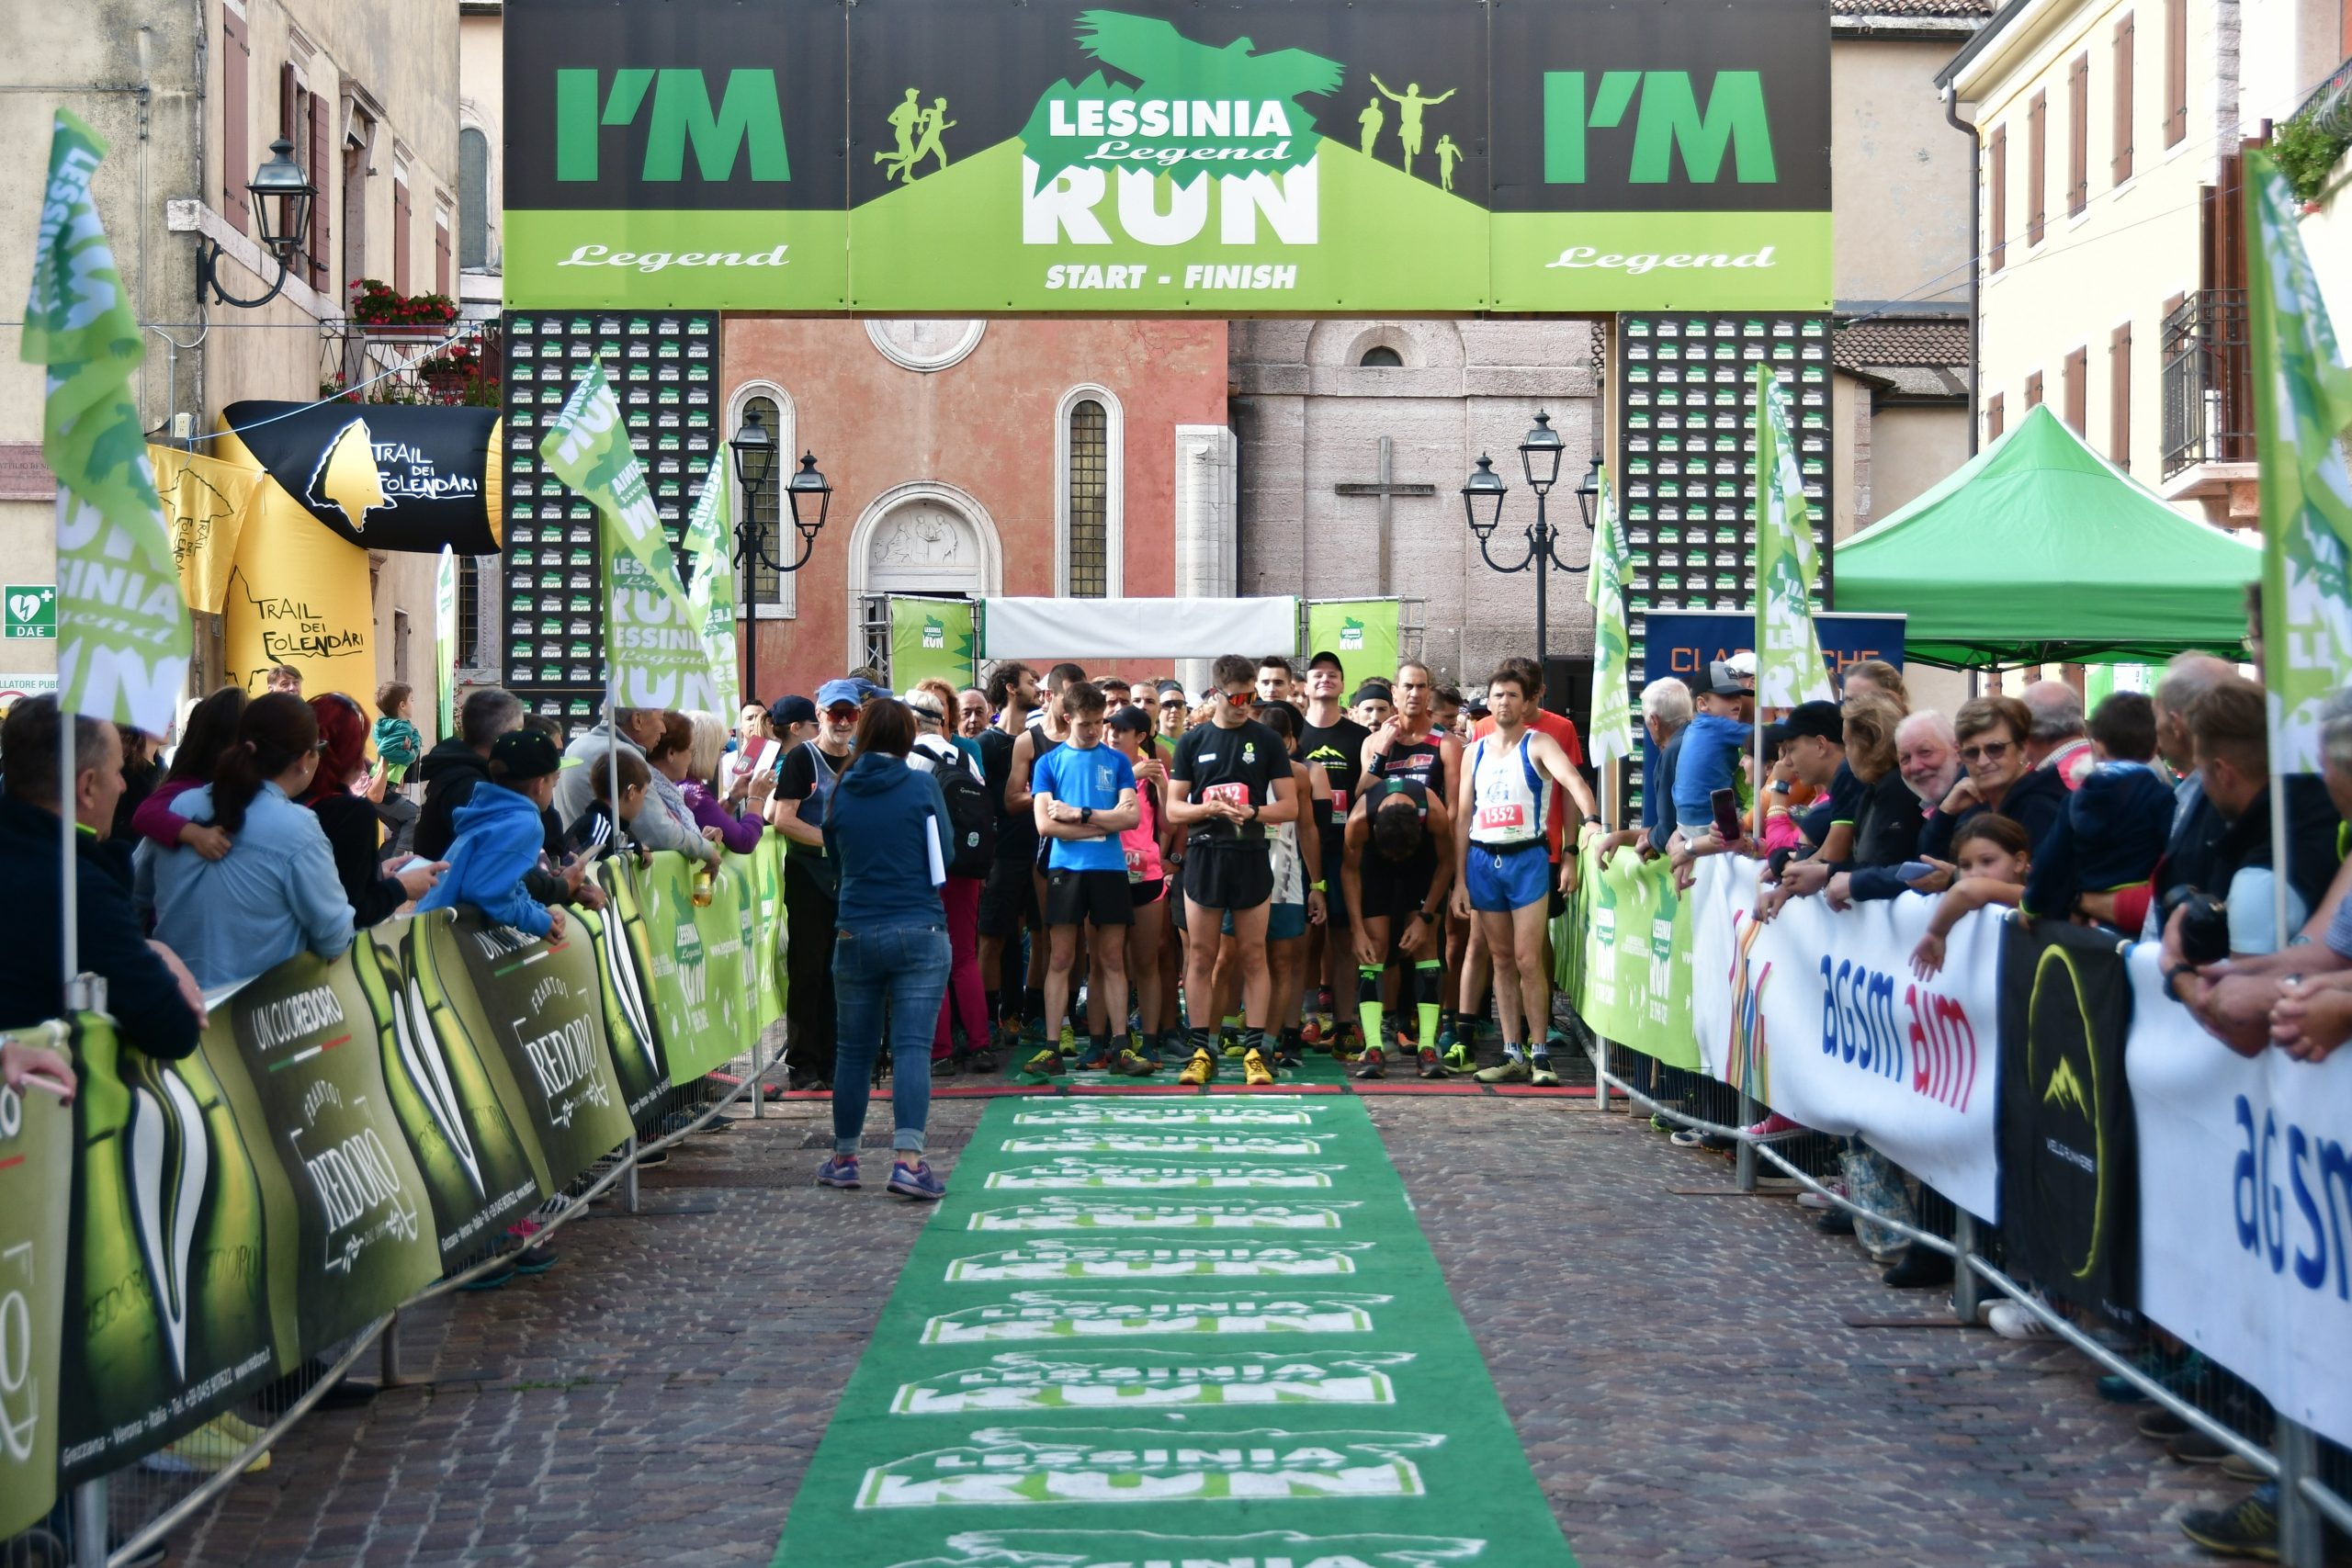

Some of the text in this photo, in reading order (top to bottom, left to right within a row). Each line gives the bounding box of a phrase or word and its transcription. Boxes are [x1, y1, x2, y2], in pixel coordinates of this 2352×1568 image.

[1050, 100, 1293, 137] LESSINIA
[1084, 141, 1292, 165] Legend
[1023, 153, 1318, 246] RUN
[558, 244, 790, 272] Legend
[1545, 246, 1776, 274] Legend
[1045, 265, 1296, 289] START - FINISH
[369, 443, 433, 463] TRAIL
[413, 467, 435, 476] DEI
[195, 519, 210, 557] TRAIL
[253, 598, 322, 620] TRAIL
[17, 626, 44, 637] DAE
[301, 623, 325, 632] DEI
[1484, 807, 1515, 824] 1552
[1125, 852, 1140, 866] 04
[531, 977, 569, 1015] FRANTOI
[525, 1013, 609, 1107] REDORO
[306, 1127, 418, 1241] REDORO
[113, 1419, 142, 1445] Verona
[149, 1405, 168, 1428] Italia
